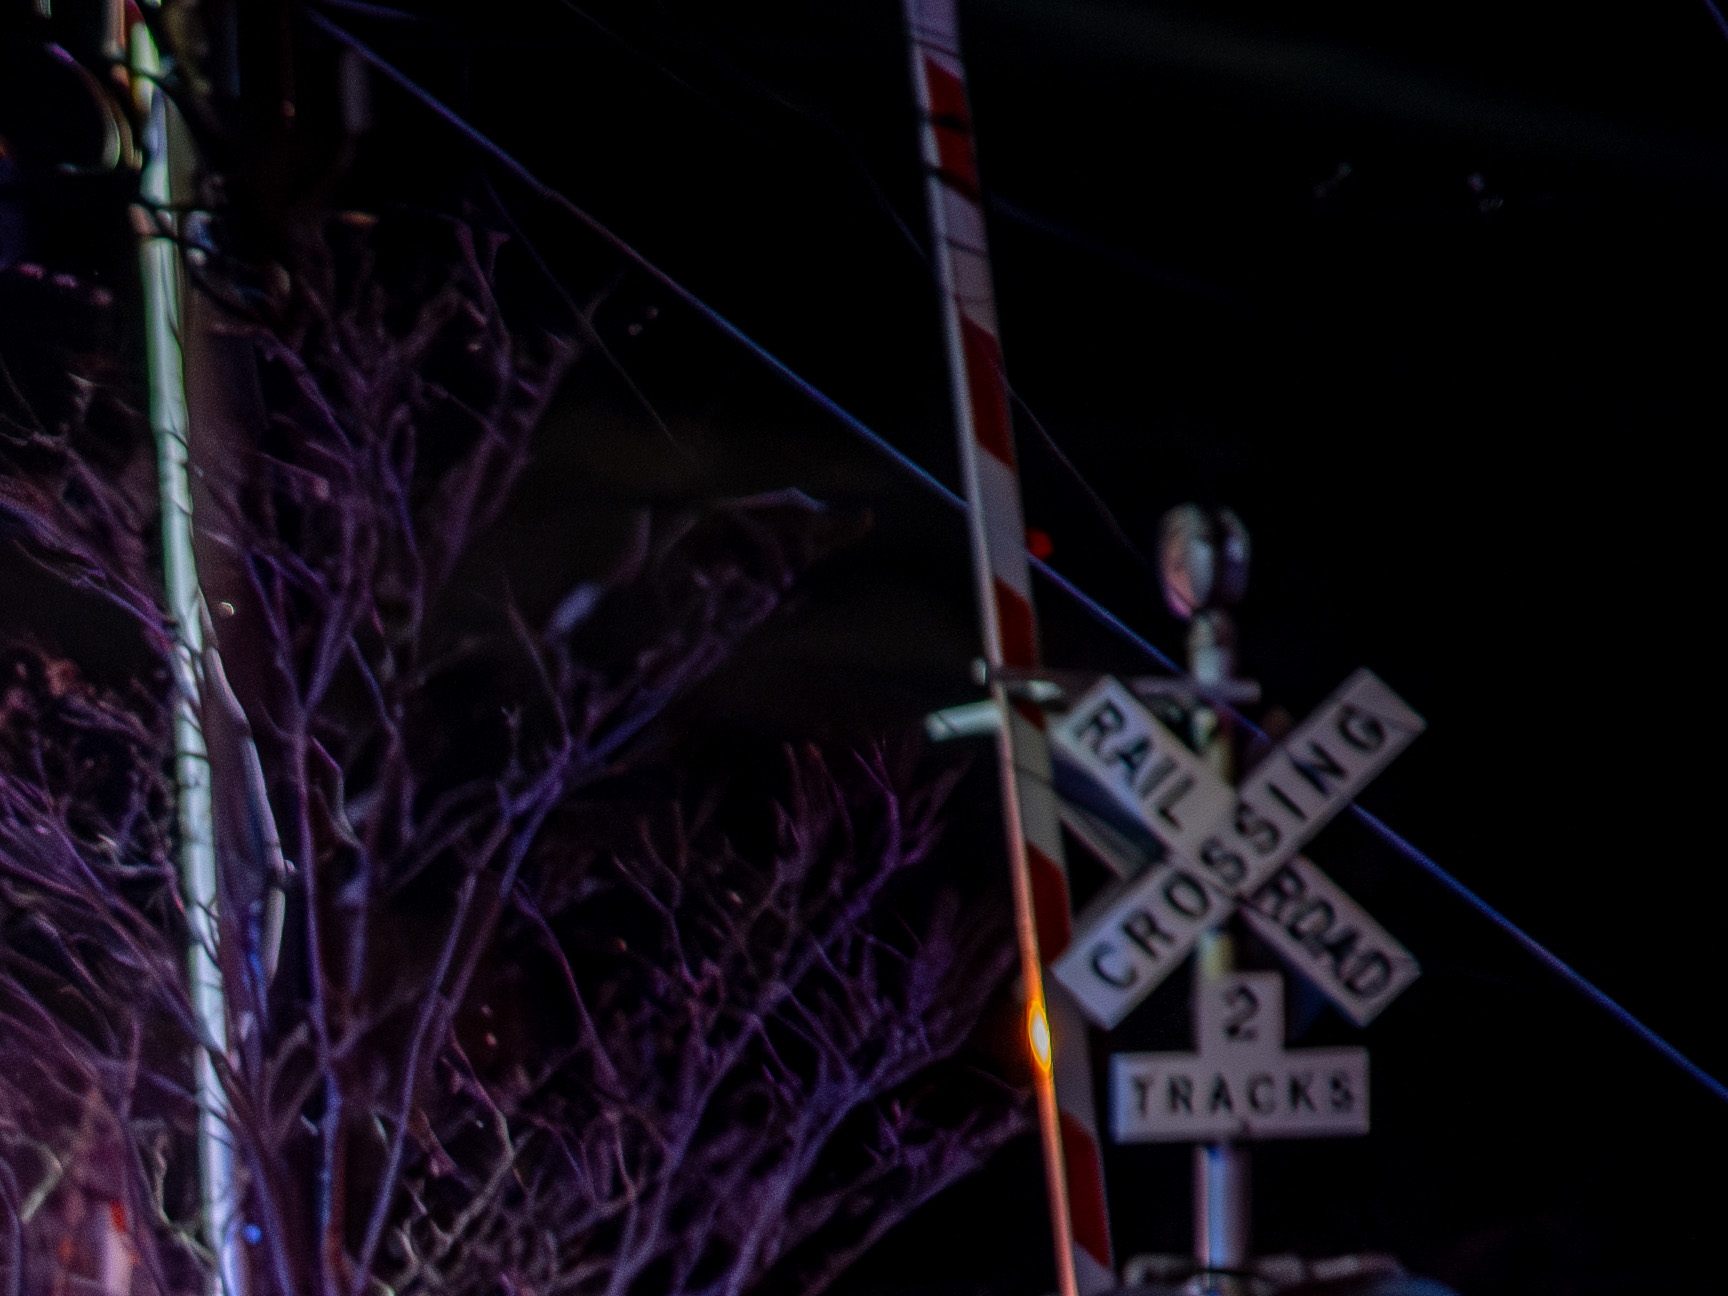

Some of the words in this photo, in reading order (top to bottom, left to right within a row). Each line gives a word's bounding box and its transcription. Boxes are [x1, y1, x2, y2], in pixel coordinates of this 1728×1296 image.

[1073, 700, 1196, 832] RAIL
[1254, 867, 1392, 998] ROAD
[1090, 703, 1385, 990] CROSSING
[1129, 1072, 1355, 1116] TRACKS
[1224, 985, 1259, 1042] 2
